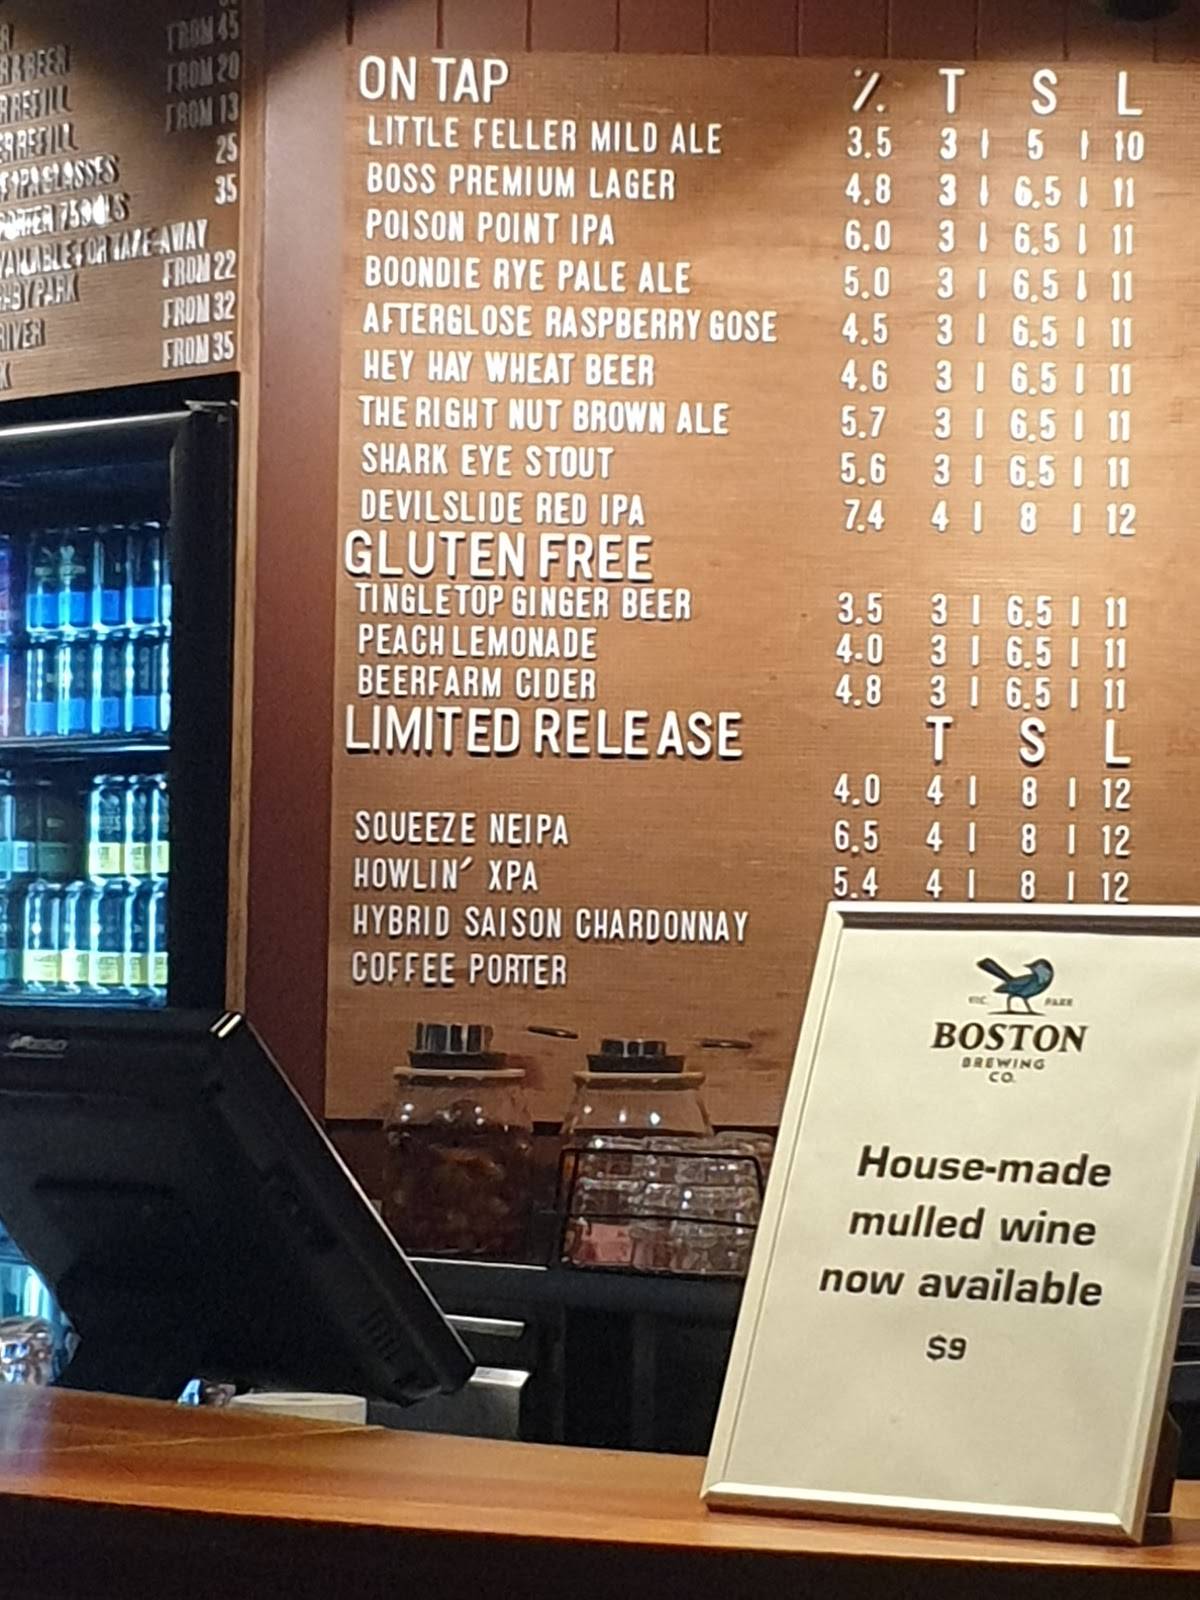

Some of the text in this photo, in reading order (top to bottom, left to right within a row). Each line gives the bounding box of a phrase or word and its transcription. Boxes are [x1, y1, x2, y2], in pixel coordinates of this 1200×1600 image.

[167, 51, 240, 94] FROM 20
[358, 54, 509, 104] ON TAP
[938, 67, 966, 114] T
[1031, 67, 1058, 115] S
[1117, 70, 1144, 116] L
[165, 91, 239, 134] FROM 13
[215, 133, 238, 165] 25
[367, 114, 723, 155] LITTLE FELLER MILD ALE
[847, 125, 1145, 162] 3.5 3 5 10
[214, 174, 238, 205] 35
[366, 161, 675, 201] BOSS PREMIUM LAGER
[844, 172, 1135, 209] 4.8 3 6.5 11
[365, 208, 615, 246] POISON POINT IPA
[844, 218, 1133, 256] 6.0 3 6.5 11
[163, 250, 236, 288] FROM 22
[364, 254, 691, 295] BOONDIE RYE PALE ALE
[844, 265, 1133, 303] 5.0 3 6.5 11
[162, 290, 236, 329] FROM 32
[362, 301, 777, 343] AFTERGLOSE RASPBERRY GOSE
[841, 312, 1132, 348] 4.5 3 6.5 11
[162, 331, 234, 369] FROM 35
[363, 349, 655, 387] HEY HAY WHEAT BEER
[840, 358, 1131, 395] 4.6 3 6.5 11
[358, 394, 729, 435] THE RIGHT NUT BROWN ALE
[841, 404, 1131, 442] 5.7 3 6.5 11
[361, 441, 614, 479] SHARK EYE STOUT
[840, 451, 1130, 488] 5.6 3 6.5 11
[360, 488, 645, 526] DEVILSLIDE RED IPA
[844, 498, 1137, 535] 7.4 4 8 12
[344, 530, 653, 581] GLUTEN FREE
[354, 583, 691, 620] TINGLETOP GINGER BEER
[837, 591, 1127, 628] 3.5 3 6.5 11
[358, 623, 597, 659] PEACH LEMONADE
[930, 634, 947, 665] 3
[1006, 635, 1052, 669] 6.5
[1104, 637, 1126, 669] 11
[357, 663, 596, 700] BEERFARM CIDER
[835, 673, 1126, 710] 4.8 3 6.5 11
[345, 703, 743, 759] LIMITED RELEASE
[925, 714, 1132, 764] T S L
[833, 772, 1132, 809] 4.0 4 8 12
[354, 809, 569, 845] SQUEEZE NEIPA
[834, 819, 1131, 856] 6.5 4 8 12
[488, 859, 539, 891] XPA
[833, 865, 1130, 903] 5.4 4 8 12
[353, 903, 749, 942] HYBRID SAISON CHARDONNAY
[351, 950, 567, 985] COFFEE PORTER
[930, 1022, 1089, 1052] BOSTON
[962, 1057, 1045, 1070] BREWING
[988, 1071, 1016, 1083] CO.
[856, 1145, 1112, 1187] House-made
[848, 1205, 1096, 1246] mulled wine
[818, 1267, 1103, 1307] now available
[925, 1334, 967, 1363] $9
